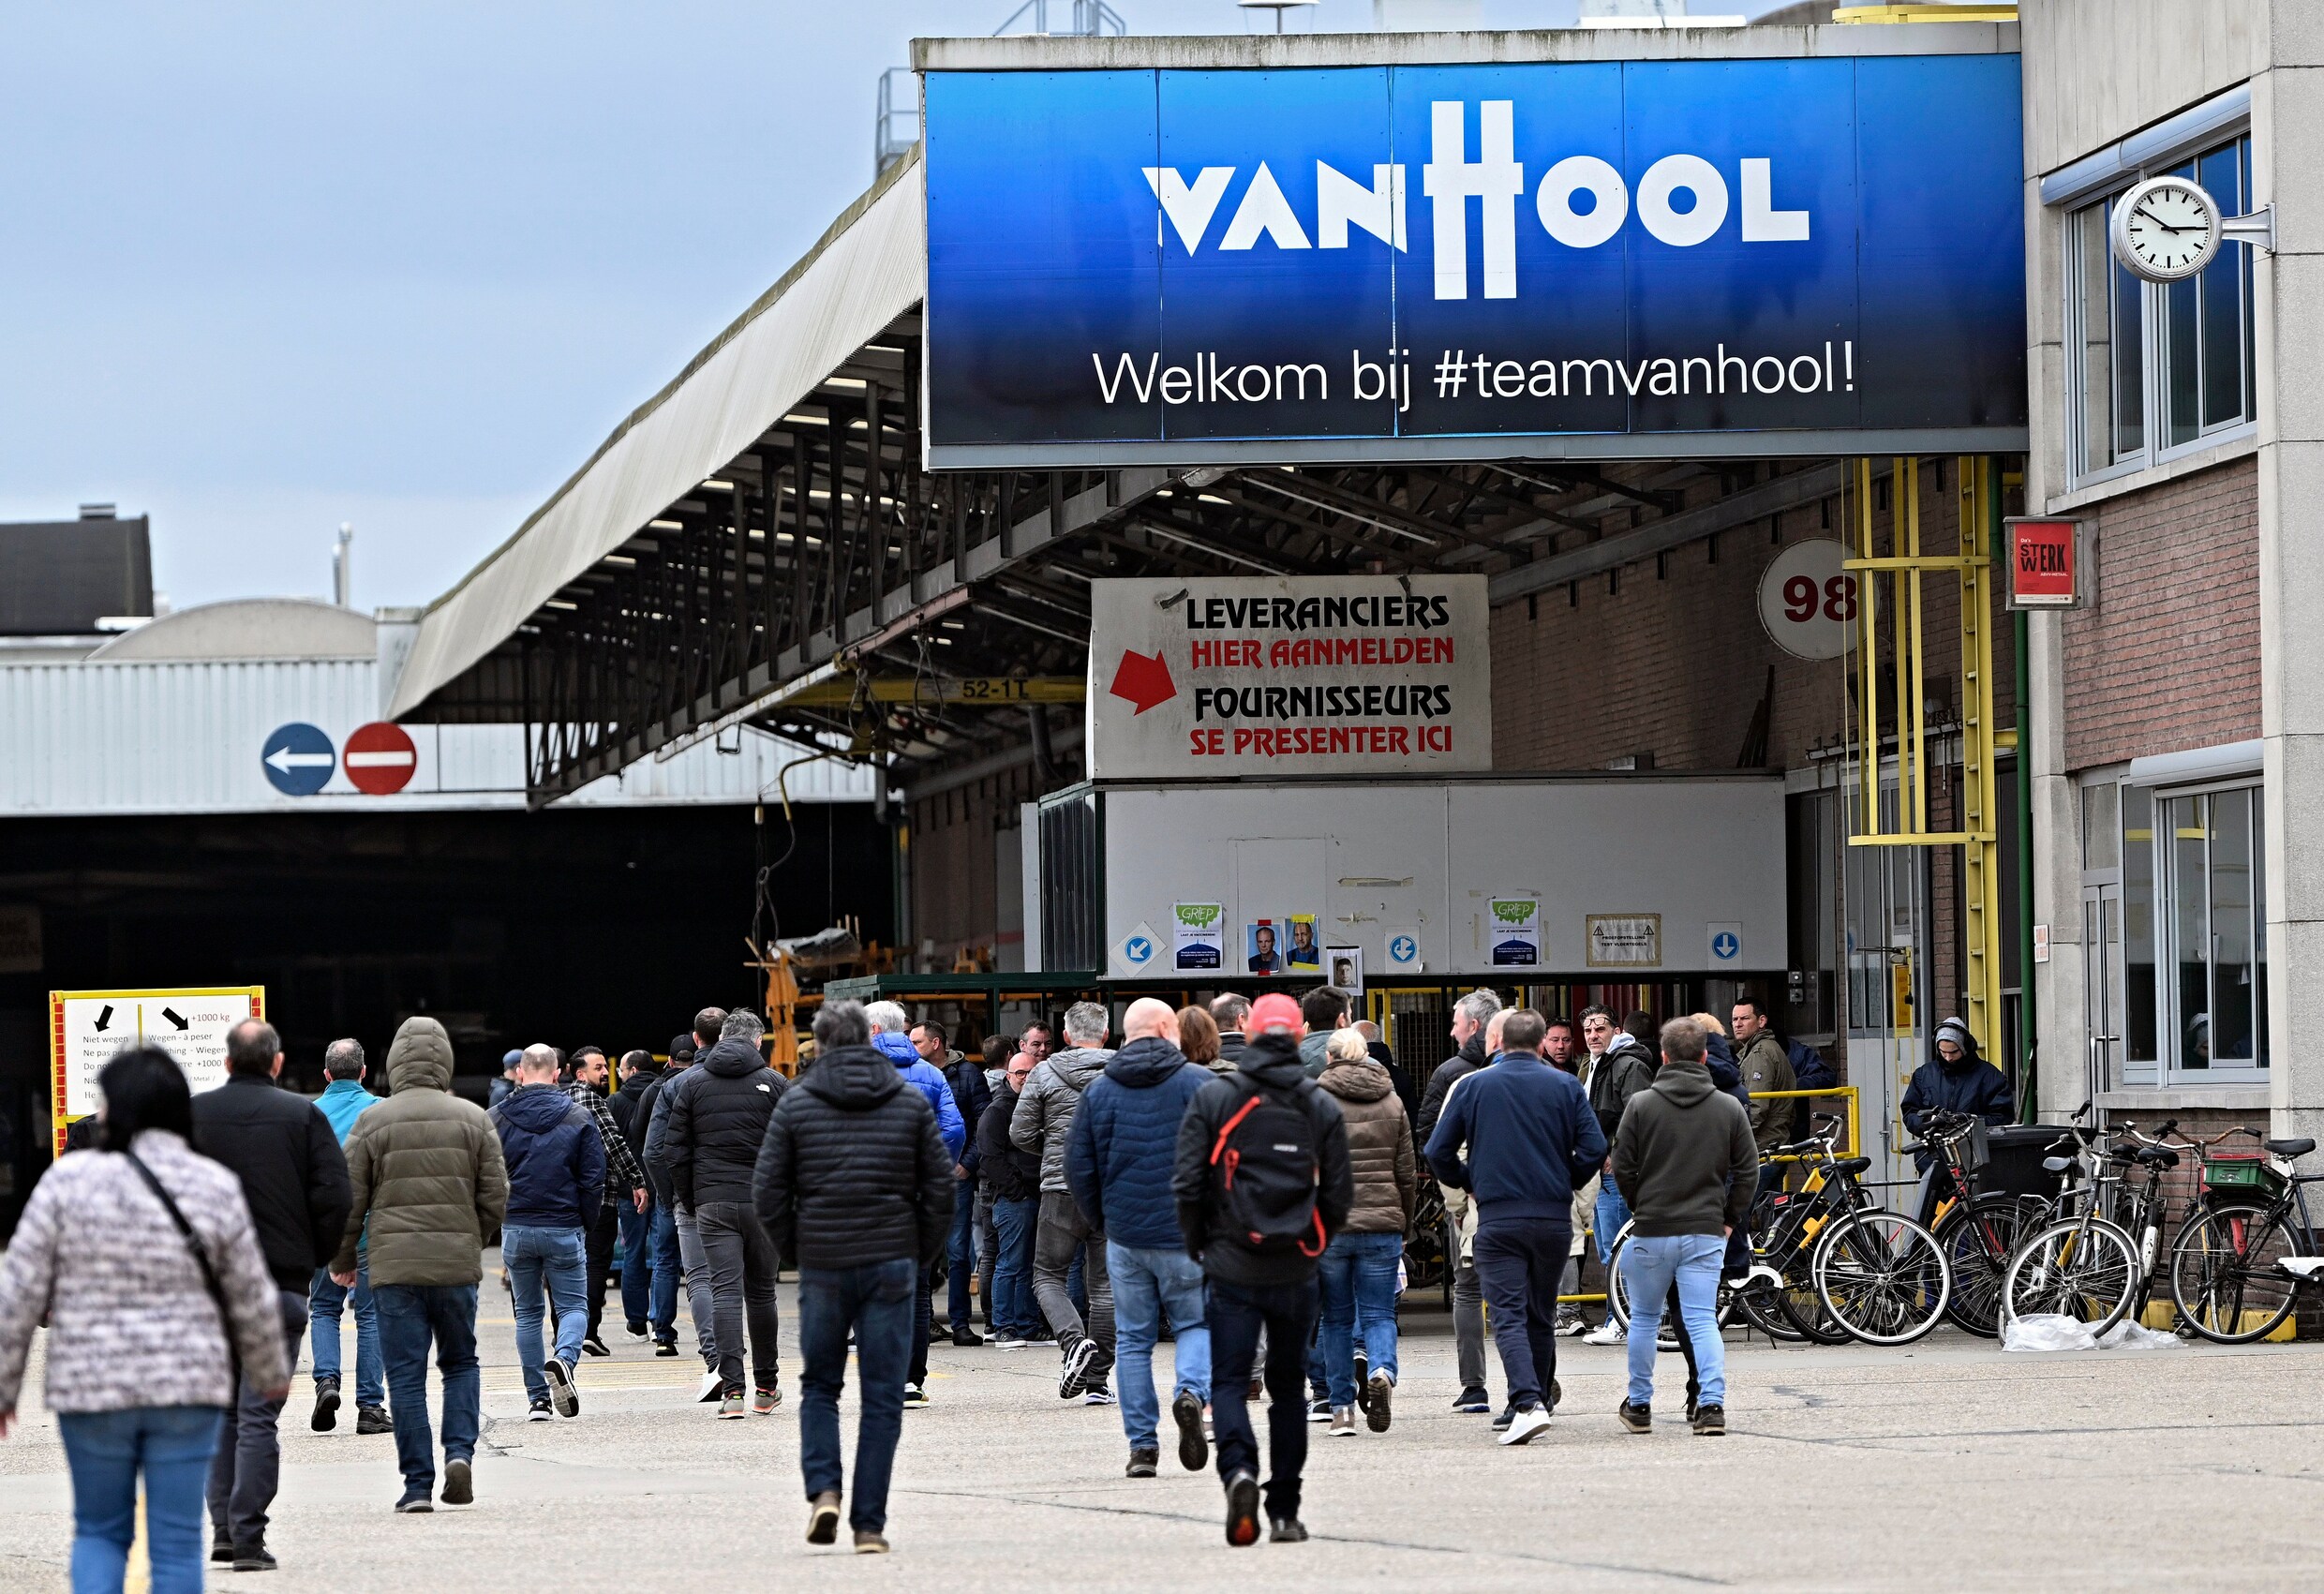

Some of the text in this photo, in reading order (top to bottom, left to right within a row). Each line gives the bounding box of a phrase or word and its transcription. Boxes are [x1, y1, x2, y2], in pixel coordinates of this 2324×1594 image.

[1093, 340, 1854, 411] Welkom bij #teamvanhool!
[1782, 574, 1857, 623] 98
[1186, 595, 1450, 632] LEVERANCIERS
[1191, 637, 1453, 670] HIER AANMELDEN
[1195, 684, 1452, 723] FOURNISSEURS
[1190, 725, 1452, 758] SE PRESENTER ICI
[1182, 906, 1214, 920] GRIEP
[1497, 903, 1530, 916] GRIEP
[191, 1013, 231, 1022] +1000 kg
[148, 1035, 176, 1043] Wegen
[196, 1046, 226, 1055] Wiegen
[197, 1059, 221, 1067] +1000
